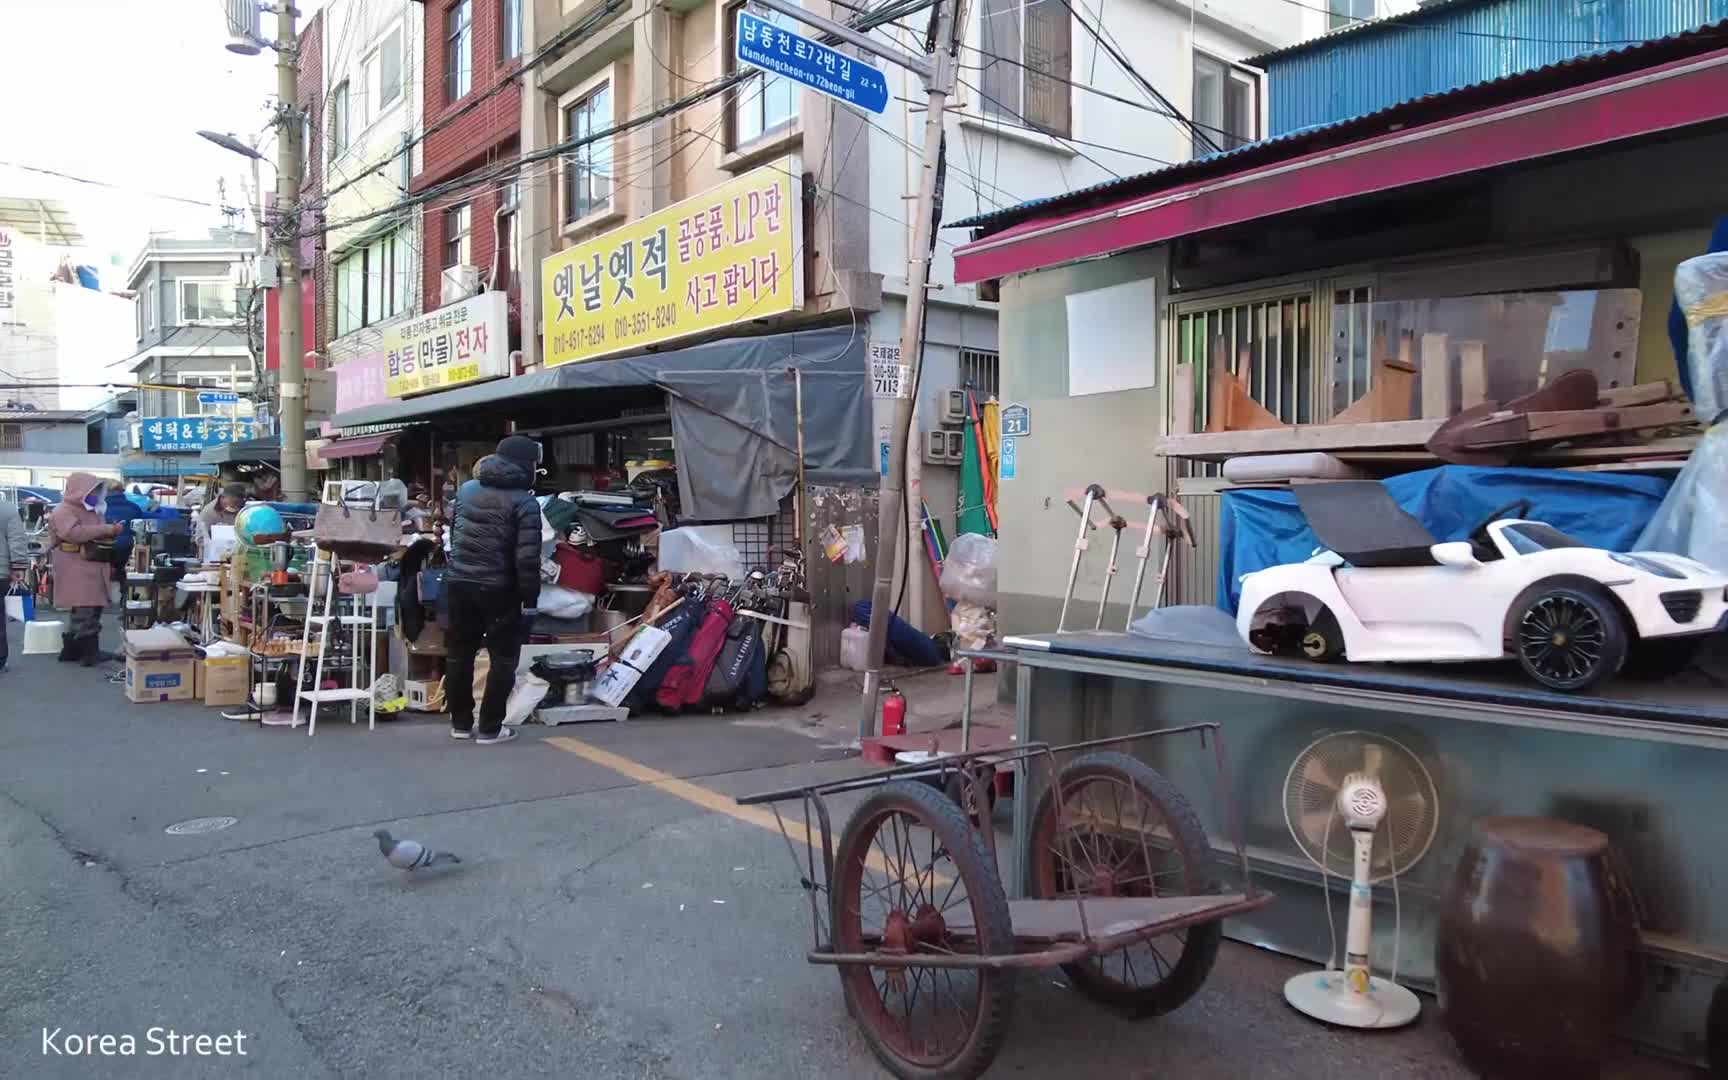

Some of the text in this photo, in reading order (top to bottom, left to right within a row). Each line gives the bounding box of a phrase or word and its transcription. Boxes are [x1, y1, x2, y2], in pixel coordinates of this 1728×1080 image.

[743, 17, 851, 81] 남동천로72번길
[741, 45, 856, 99] Namdongcheon-ro 72beon-gil
[615, 302, 677, 340] 010-3551-8240
[874, 379, 899, 393] 7113
[1007, 419, 1021, 433] 21
